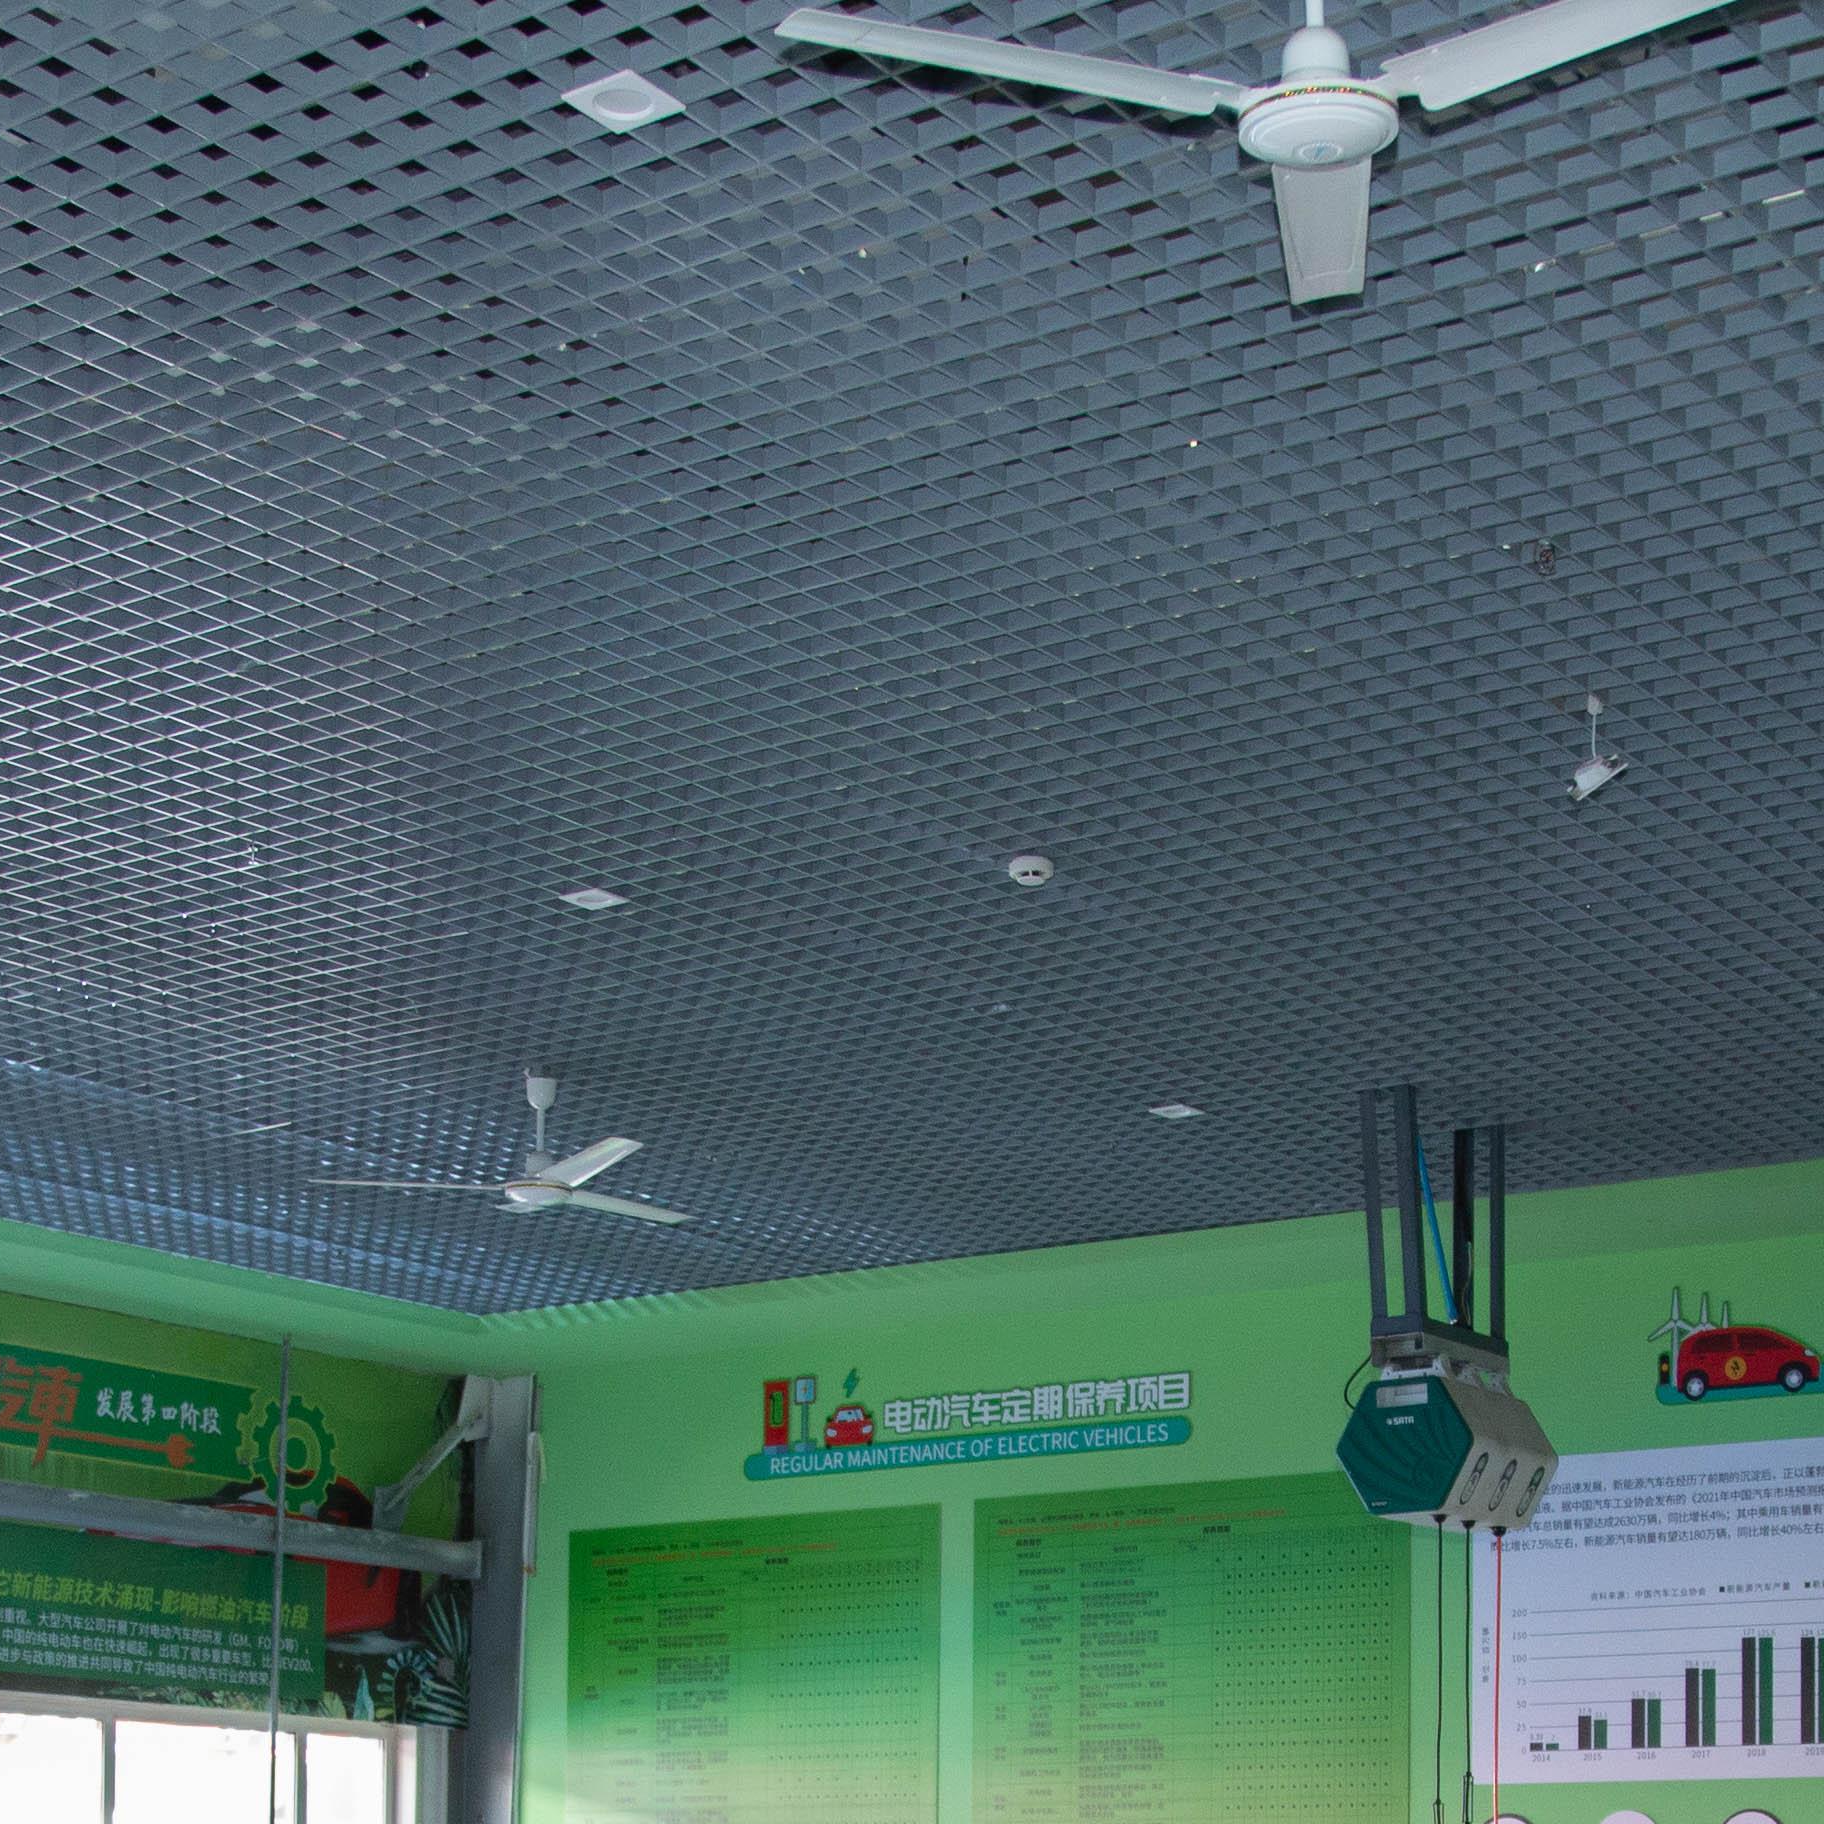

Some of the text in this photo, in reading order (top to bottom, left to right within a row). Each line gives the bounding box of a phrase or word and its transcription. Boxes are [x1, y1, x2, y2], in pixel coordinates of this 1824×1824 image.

[96, 1387, 223, 1437] 发展第四阶段
[883, 1373, 1191, 1433] 电动汽车定期保养项目
[1392, 1416, 1415, 1426] SATA
[770, 1423, 1169, 1475] REGULAR MAINTENANCE OF ELECTRIC VEHICLES
[1512, 1608, 1527, 1618] 200
